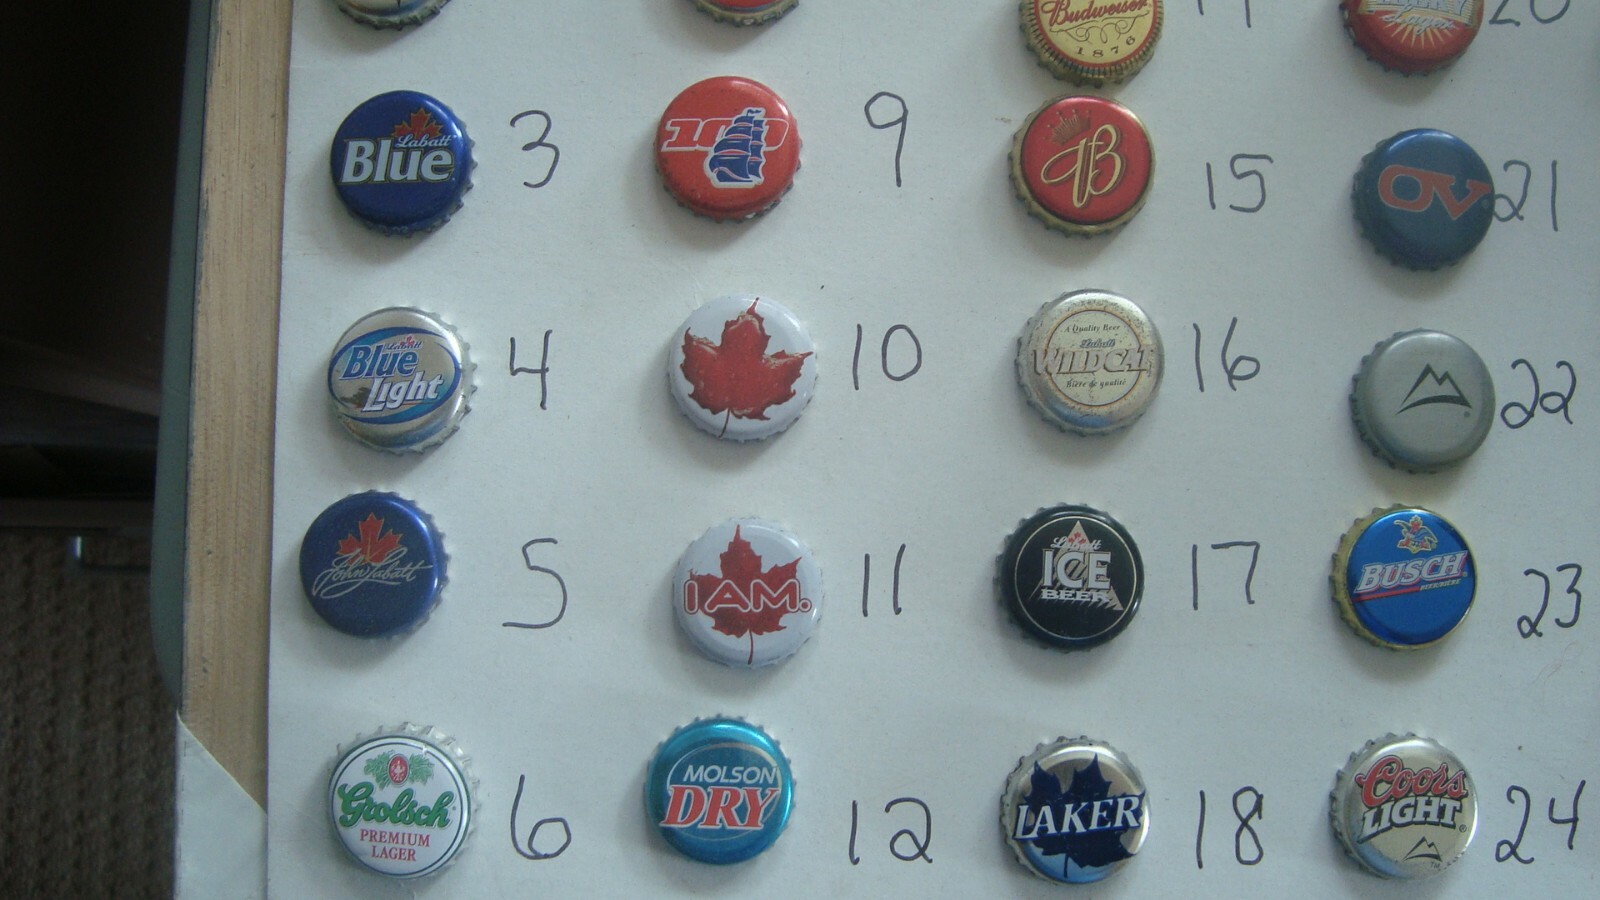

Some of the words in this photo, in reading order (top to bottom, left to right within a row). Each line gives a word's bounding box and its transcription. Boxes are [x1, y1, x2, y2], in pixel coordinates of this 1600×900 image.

[1041, 0, 1149, 27] Budweiser
[1077, 35, 1137, 58] 1876
[338, 137, 455, 185] Blue
[396, 134, 452, 149] Labatt
[510, 109, 560, 189] 3
[864, 91, 909, 188] 9
[1205, 153, 1275, 214] 15
[1377, 164, 1493, 221] OV
[1493, 160, 1560, 232] 21
[1072, 323, 1101, 334] Quality
[1103, 324, 1121, 333] Beer
[340, 343, 419, 381] Blue
[510, 328, 553, 410] 4
[852, 323, 922, 391] 10
[1033, 347, 1154, 375] WILDCAT
[1193, 317, 1261, 393] 16
[361, 370, 446, 413] Light
[1500, 358, 1577, 430] 22
[502, 537, 568, 629] 5
[862, 543, 906, 618] 11
[1042, 548, 1111, 589] ICE
[1192, 540, 1261, 611] 17
[1353, 549, 1468, 594] BUSCH
[1040, 587, 1111, 603] BEER
[1517, 563, 1583, 639] 23
[683, 764, 778, 785] MOLSON
[1355, 755, 1469, 808] Coors
[336, 780, 456, 829] Grolsch
[510, 774, 572, 861] 6
[659, 784, 781, 830] DRY
[1013, 795, 1143, 841] LAKER
[1196, 786, 1264, 870] 18
[1357, 796, 1463, 843] LIGHT
[1495, 780, 1586, 865] 24
[359, 828, 431, 848] PREMIUM
[371, 845, 417, 862] LAGER
[849, 797, 934, 866] 12
